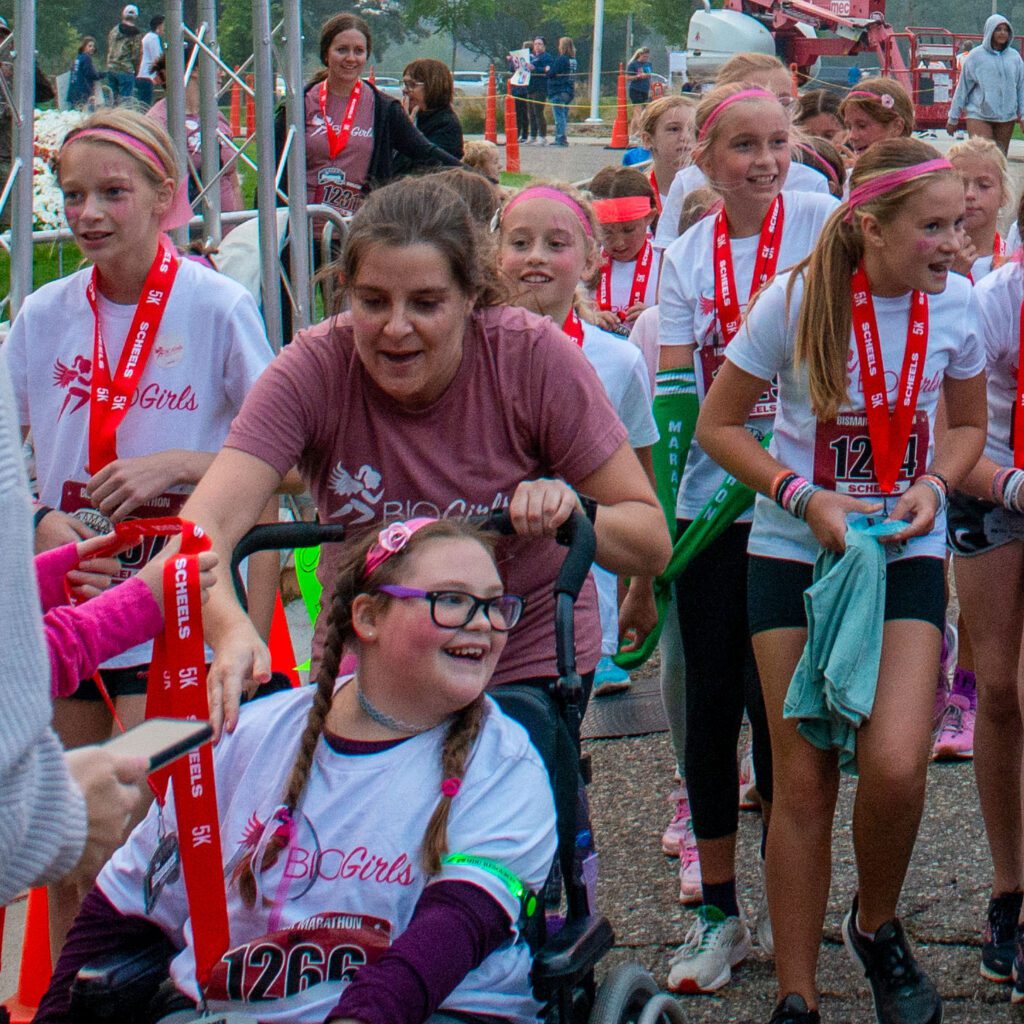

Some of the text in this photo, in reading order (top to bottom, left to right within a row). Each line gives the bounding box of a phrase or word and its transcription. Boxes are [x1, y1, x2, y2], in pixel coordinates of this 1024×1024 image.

[719, 259, 731, 306] SCHEELS
[726, 319, 737, 334] 5K
[912, 320, 924, 336] 5K
[111, 289, 164, 411] 5K SCHEELS 5K
[854, 290, 884, 409] 5K SCHEELS 5K
[96, 387, 109, 402] 5K
[904, 352, 919, 407] SCHEELS
[829, 433, 918, 479] 124
[848, 483, 900, 493] SCHES
[174, 557, 191, 640] SCHEELS
[178, 667, 199, 689] 5K
[191, 824, 212, 848] 5K
[282, 846, 416, 886] BIOGirls
[298, 916, 363, 931] MARATHON
